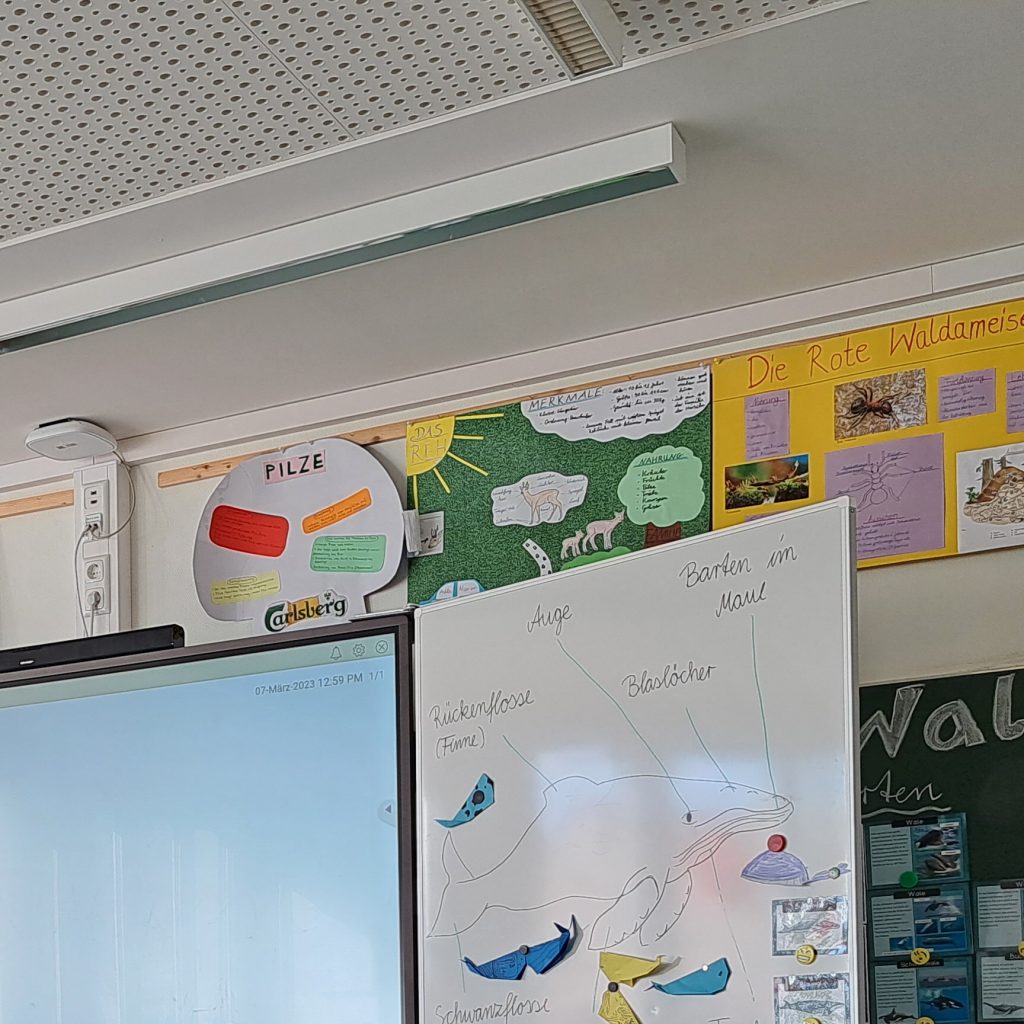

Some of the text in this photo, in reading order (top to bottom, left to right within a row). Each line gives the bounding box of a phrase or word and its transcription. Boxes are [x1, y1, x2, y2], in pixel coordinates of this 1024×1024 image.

[748, 355, 789, 389] Die
[807, 337, 871, 376] Rote
[265, 452, 324, 481] PILZE
[679, 534, 798, 588] Barten im
[264, 597, 347, 632] Carlsberg
[715, 582, 767, 618] Maul
[527, 604, 573, 636] Auge
[255, 670, 384, 696] 07-März-2023 12:59 PM 1/1
[621, 661, 716, 698] Blaslöcher
[429, 690, 535, 729] Rückenflosse
[436, 727, 486, 759] (Finne)
[905, 818, 925, 826] Wale
[908, 889, 927, 897] Wale
